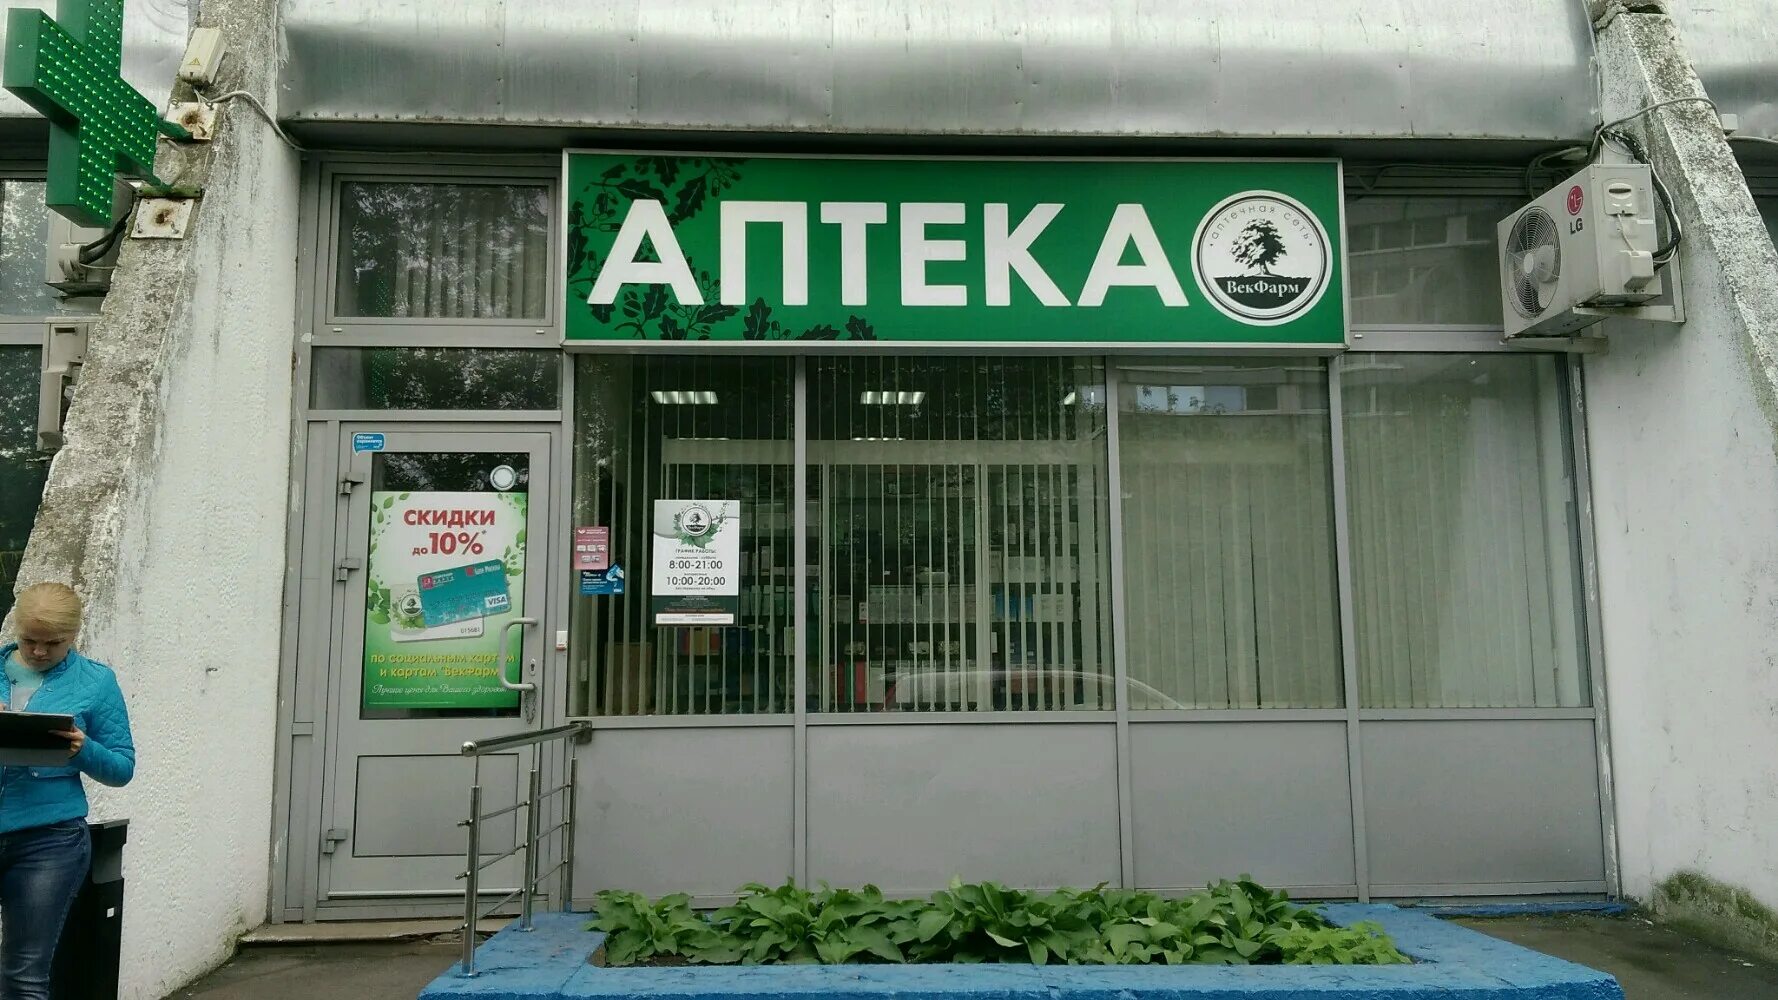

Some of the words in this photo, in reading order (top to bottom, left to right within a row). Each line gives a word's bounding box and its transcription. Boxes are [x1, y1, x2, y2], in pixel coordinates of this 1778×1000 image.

[1212, 204, 1275, 240] аптечная
[1283, 211, 1311, 240] сеть
[1569, 217, 1584, 235] LG
[586, 199, 1190, 307] АПТЕКА
[1226, 280, 1300, 298] ВекФарм
[403, 509, 496, 529] СКИДКИ
[412, 547, 429, 556] до
[669, 560, 723, 570] 8:00-21:00
[667, 576, 726, 586] 10:00-20:00
[488, 596, 507, 606] VISA
[370, 654, 385, 663] по
[389, 654, 467, 664] социальным
[470, 654, 516, 665] картм
[380, 667, 388, 677] и
[390, 667, 438, 679] картам
